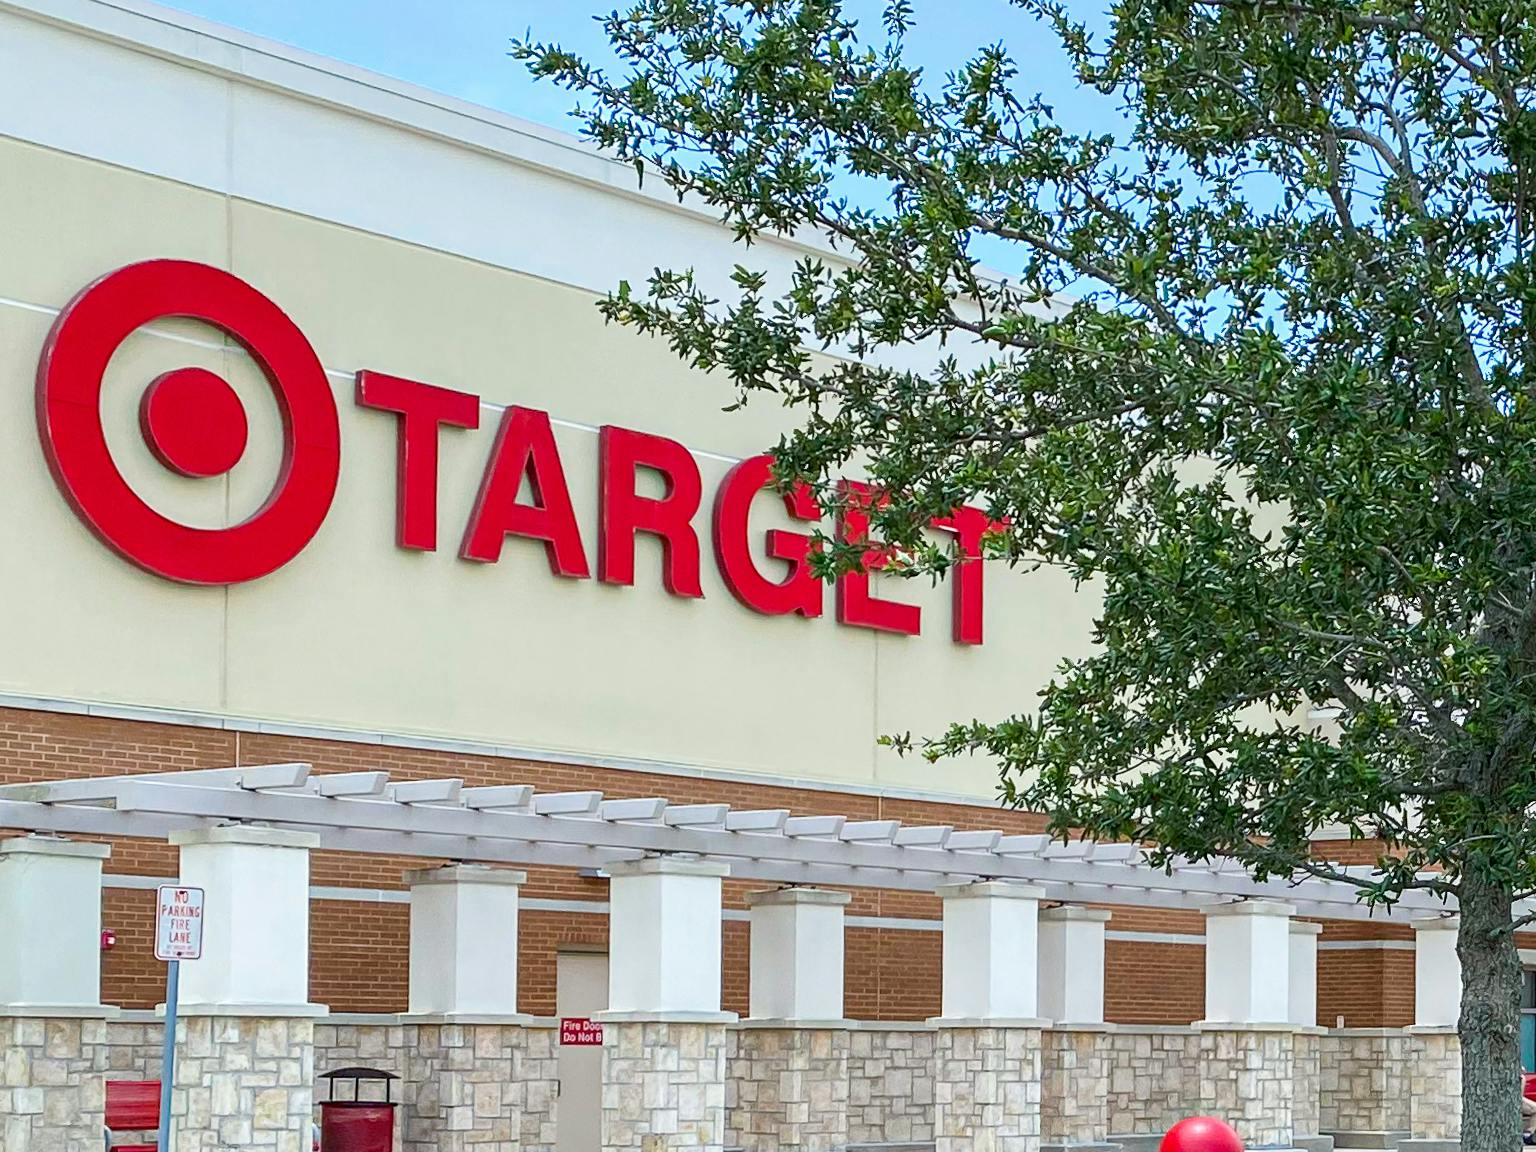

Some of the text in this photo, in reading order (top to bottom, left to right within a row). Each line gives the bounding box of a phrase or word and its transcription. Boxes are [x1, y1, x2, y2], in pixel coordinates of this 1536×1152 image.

[175, 890, 189, 904] NO
[161, 904, 200, 918] PARKING
[170, 918, 191, 931] FIRE
[169, 931, 192, 944] LANE
[563, 1020, 581, 1031] Fire
[563, 1032, 576, 1042] Do
[577, 1032, 594, 1042] Not
